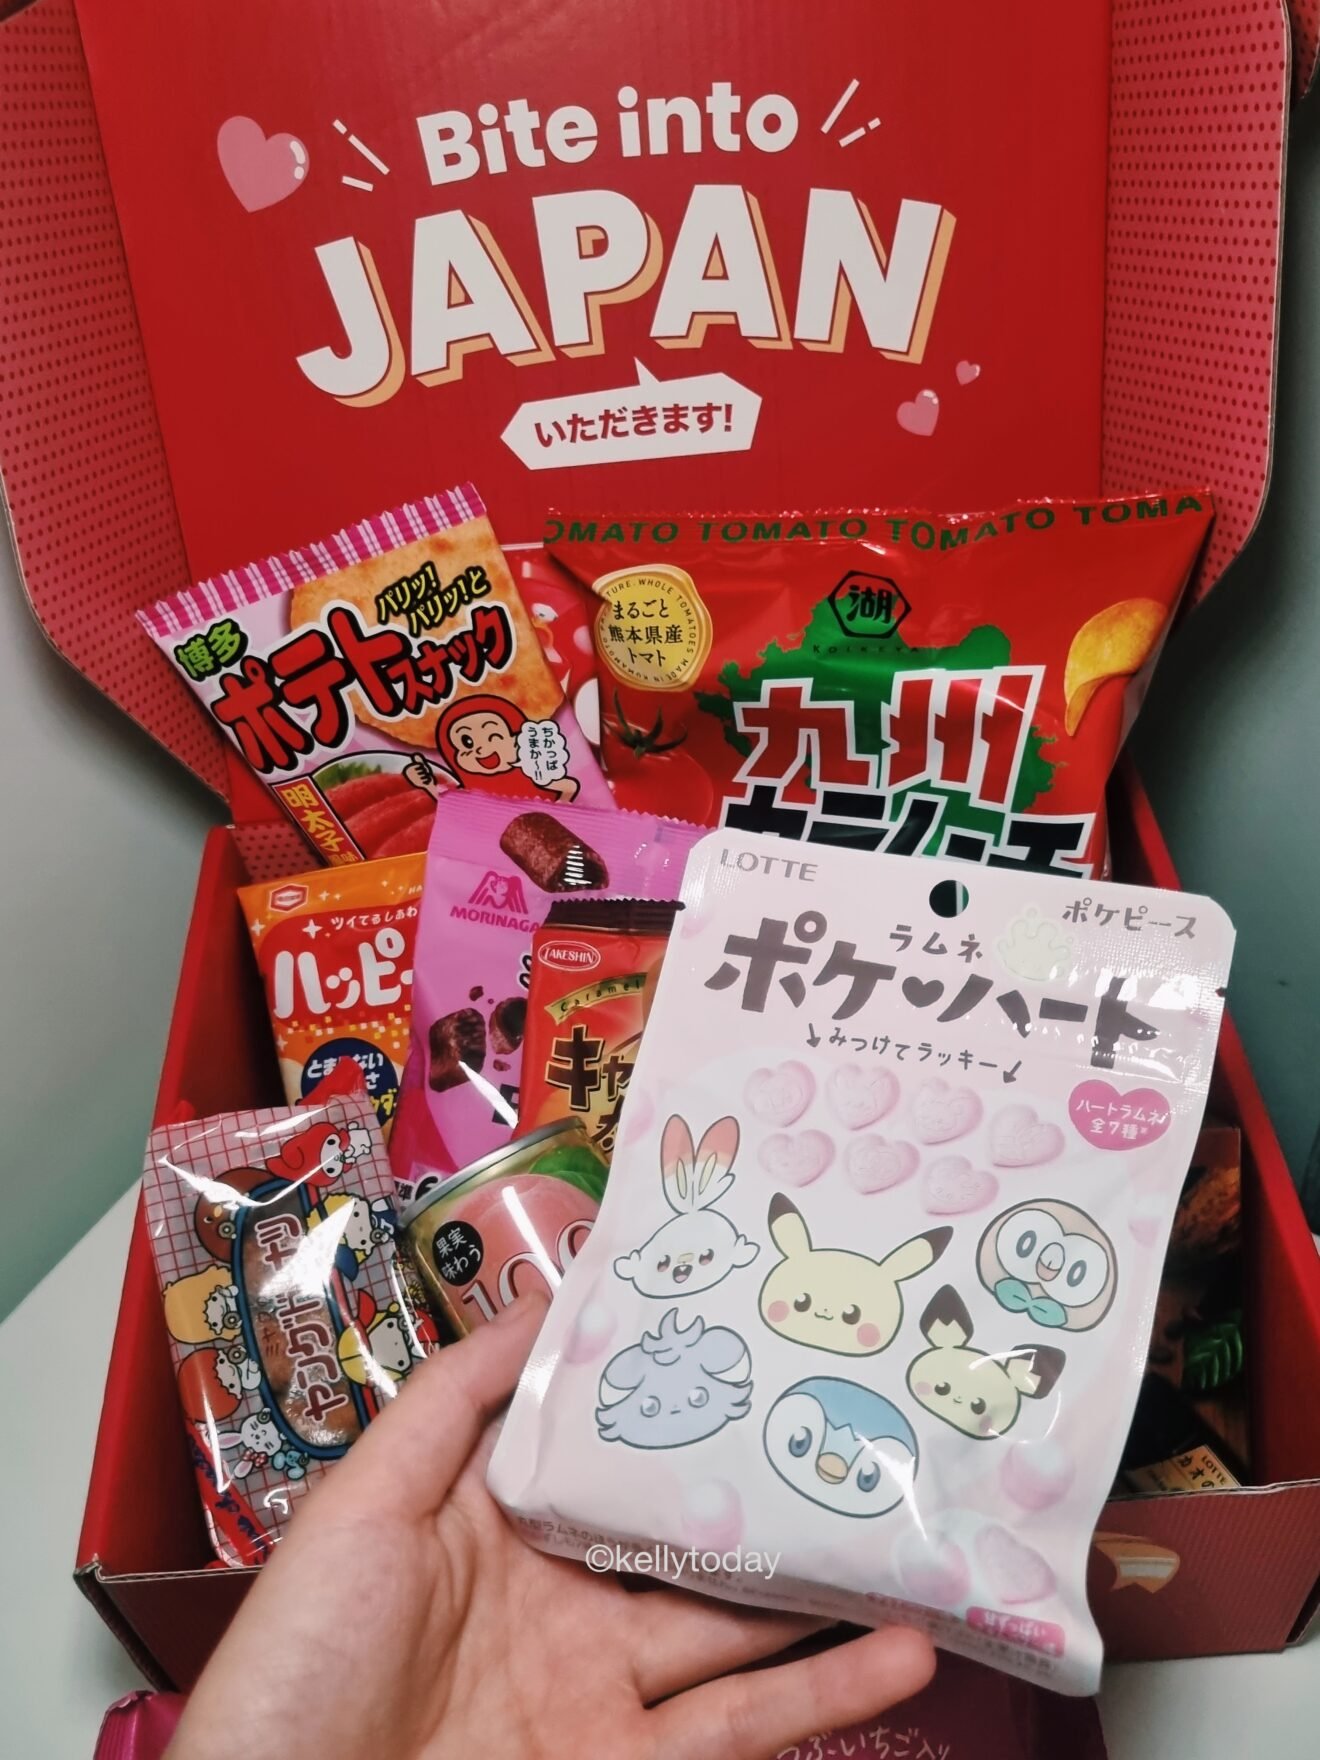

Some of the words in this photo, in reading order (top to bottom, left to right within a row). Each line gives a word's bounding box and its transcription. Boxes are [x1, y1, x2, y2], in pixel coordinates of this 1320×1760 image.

[416, 98, 599, 186] Bite
[619, 81, 799, 157] into
[296, 184, 956, 407] JAPAN
[533, 402, 734, 448] いただきます!
[698, 516, 869, 544] TOMATO
[886, 507, 1056, 551] TOMATO
[1073, 495, 1203, 526] TOMA
[613, 598, 670, 620] まるごと
[638, 578, 675, 595] WHOLE
[676, 594, 697, 655] TOMATOES
[845, 584, 893, 625] 湖
[175, 618, 247, 677] 博多
[608, 624, 683, 645] 熊本県産
[627, 647, 666, 667] トマト
[541, 726, 559, 771] ちかっぱ
[733, 664, 1045, 812] 九州
[281, 783, 345, 853] 明太子
[720, 848, 819, 882] LOTTE
[450, 905, 541, 934] MORINAGA
[1061, 896, 1198, 939] ポケピース
[543, 945, 597, 965] TAKESHIN
[889, 923, 984, 964] ラムネ
[828, 1027, 998, 1070] みつけてラッキー
[1075, 1099, 1165, 1126] ハートラムネ
[436, 1226, 468, 1260] 果実
[441, 1244, 482, 1280] 味わう
[255, 1213, 348, 1421] ヤングドナツ
